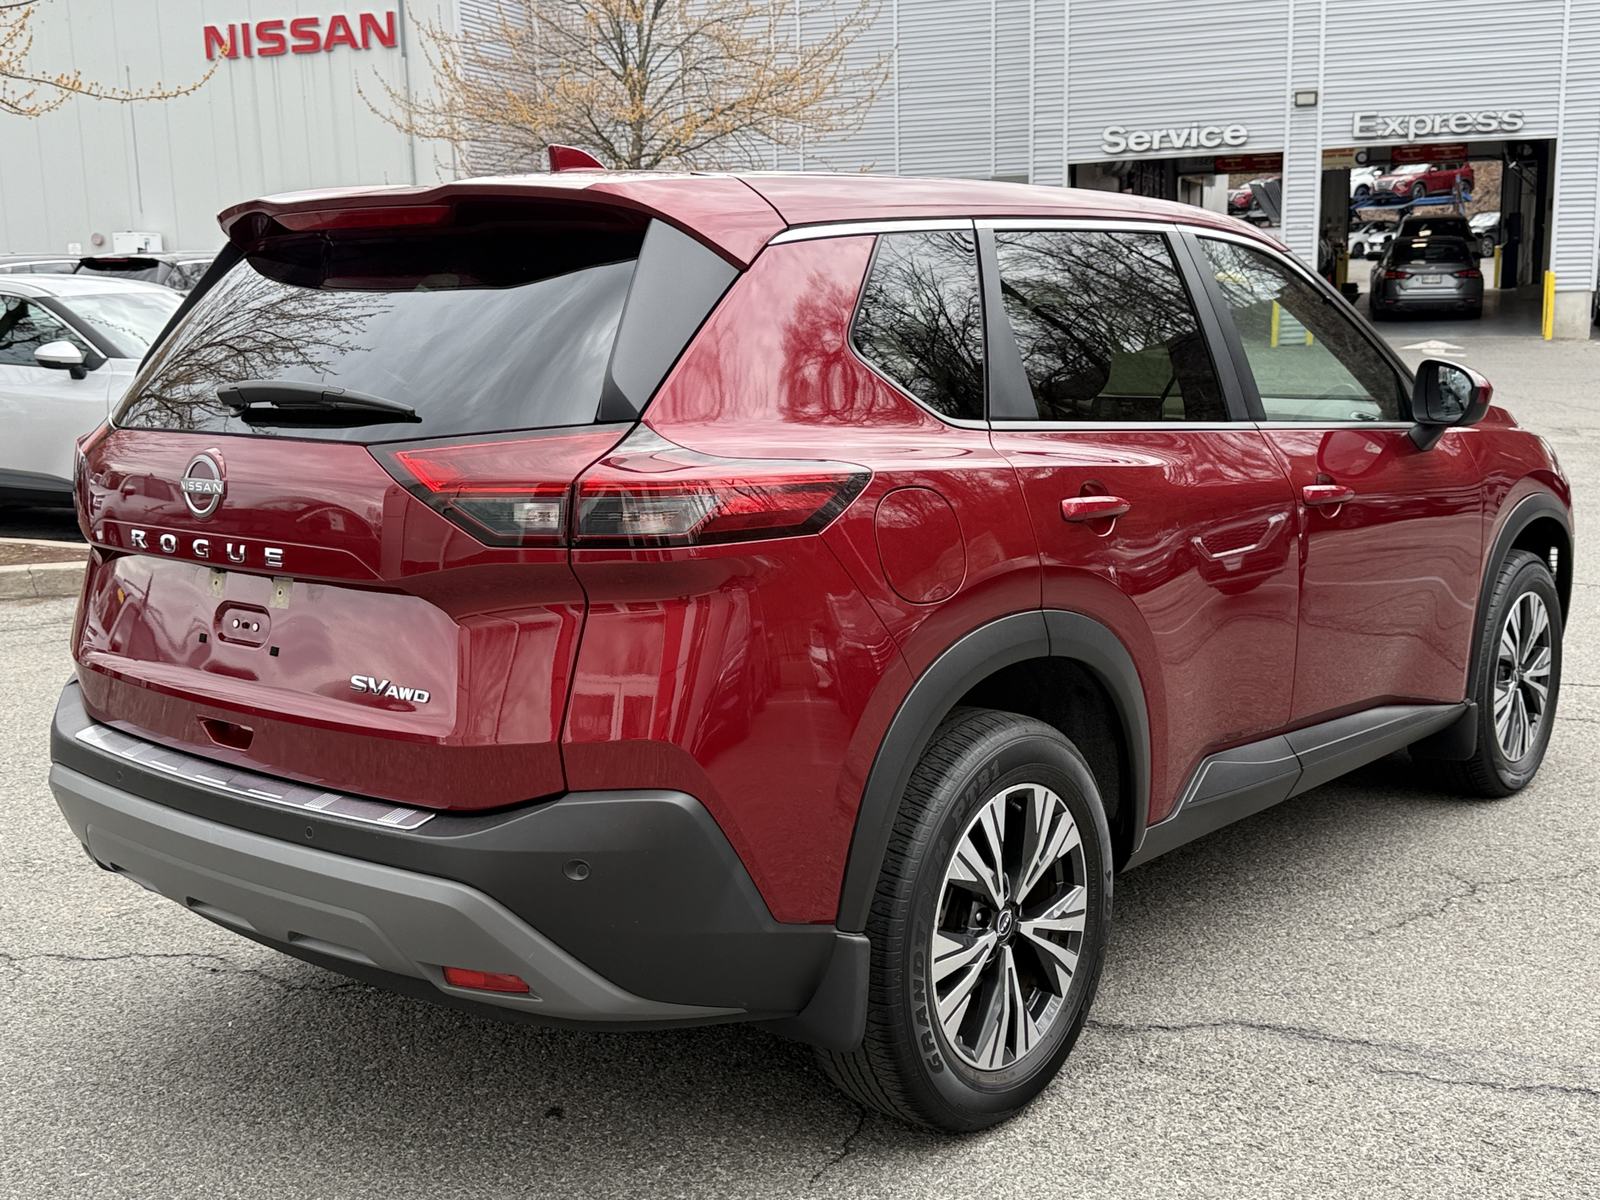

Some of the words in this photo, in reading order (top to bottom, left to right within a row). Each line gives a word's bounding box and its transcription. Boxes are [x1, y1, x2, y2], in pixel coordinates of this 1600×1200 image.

[203, 11, 396, 60] NISSAN
[1101, 122, 1249, 154] Service
[1352, 109, 1525, 141] Express
[181, 480, 222, 493] NISSAN
[131, 528, 284, 567] ROGUE
